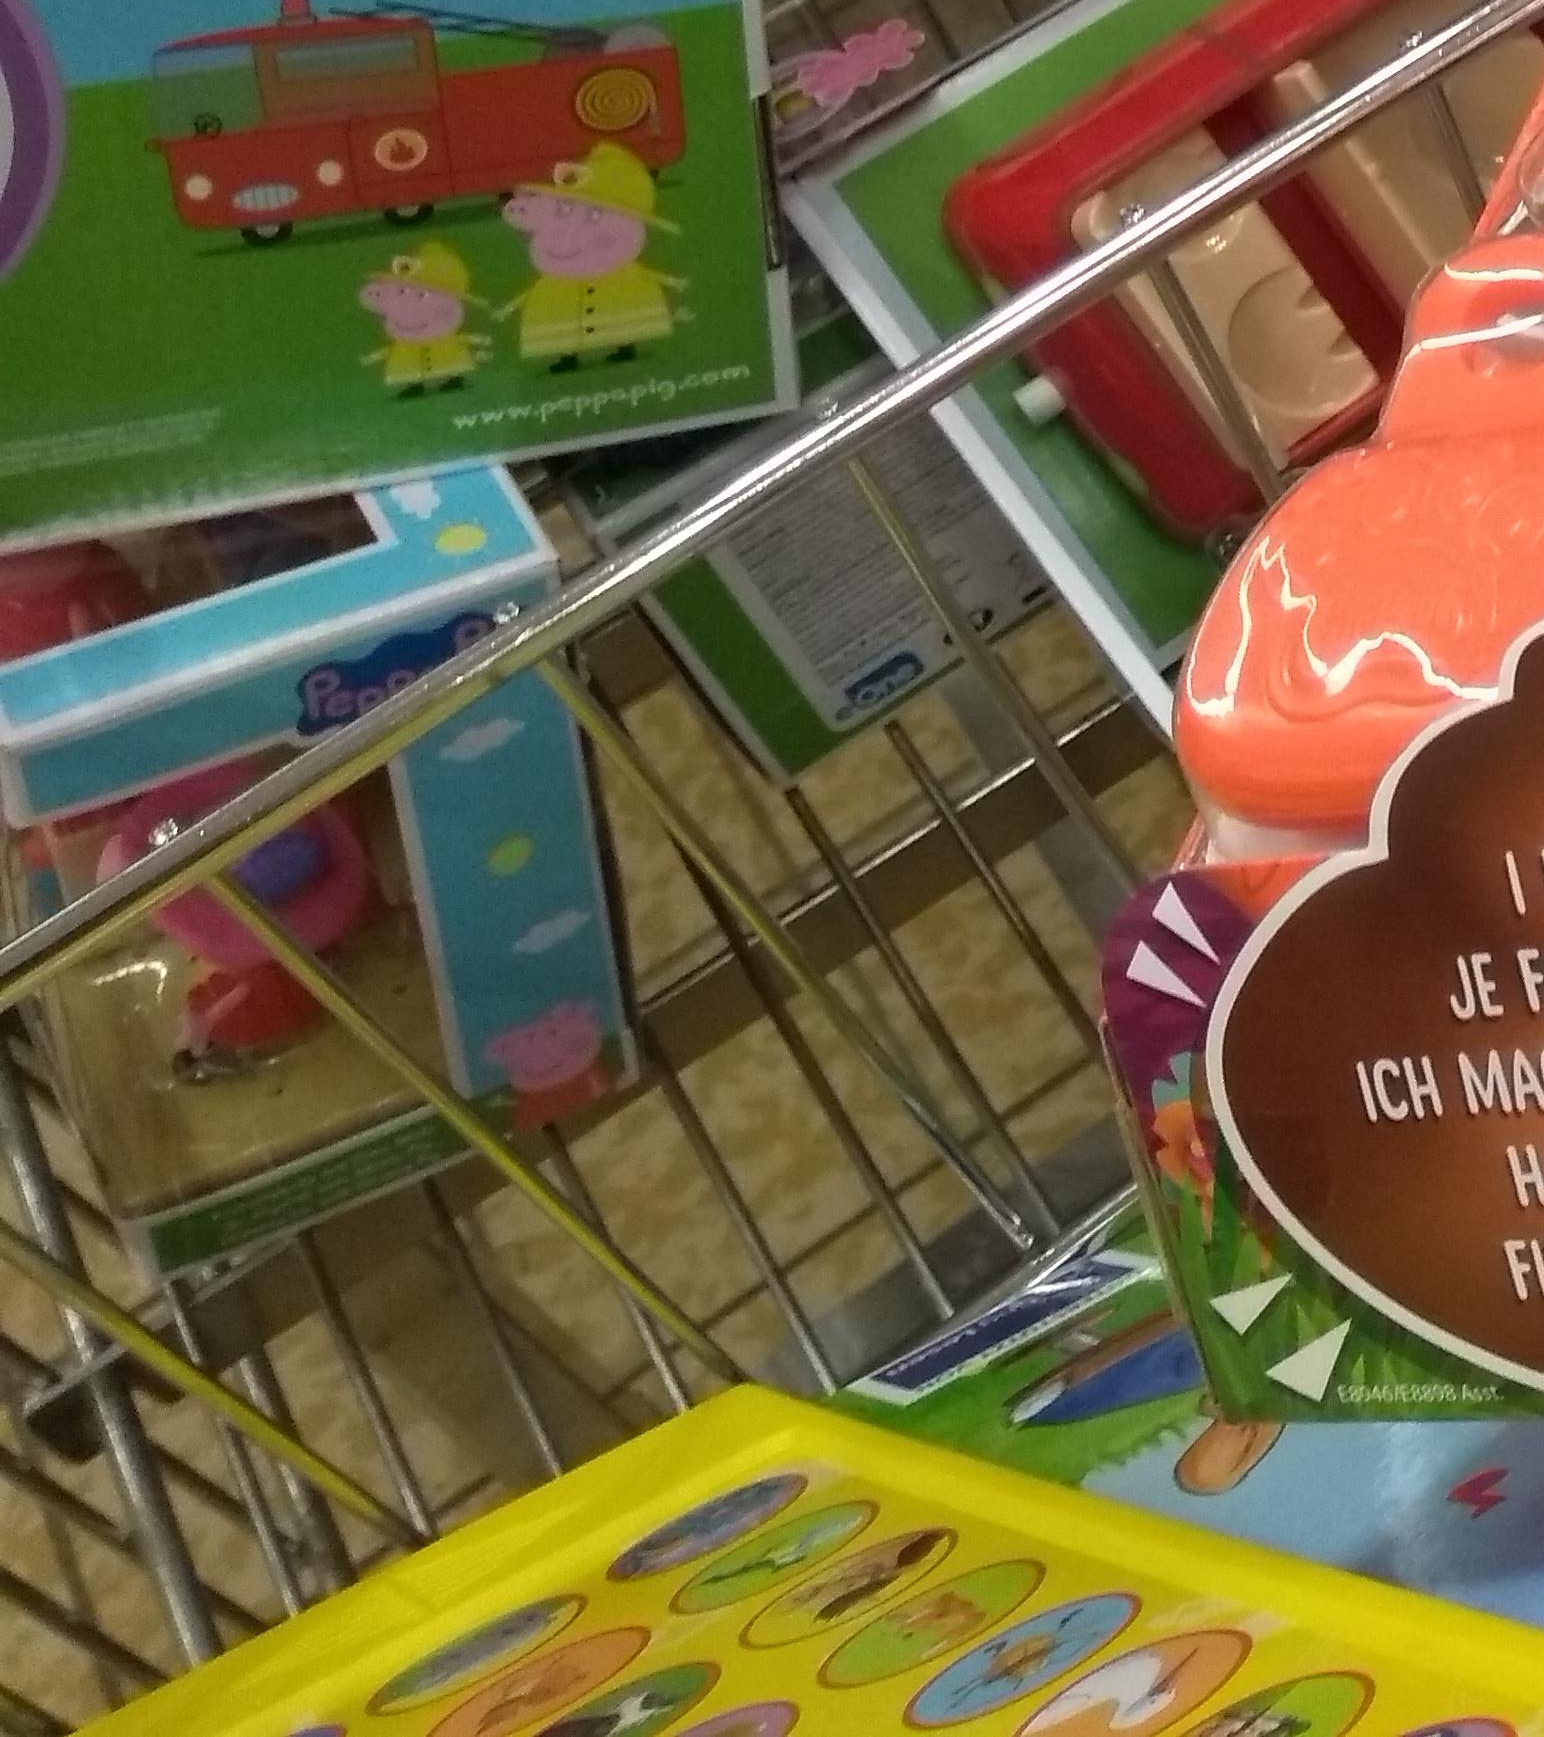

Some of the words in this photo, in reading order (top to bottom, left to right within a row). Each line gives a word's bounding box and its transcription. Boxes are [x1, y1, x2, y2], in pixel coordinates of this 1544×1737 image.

[450, 363, 750, 430] www.peppapig.com
[1505, 850, 1527, 915] I
[1449, 952, 1504, 1022] JE
[1356, 1054, 1444, 1124] ICH
